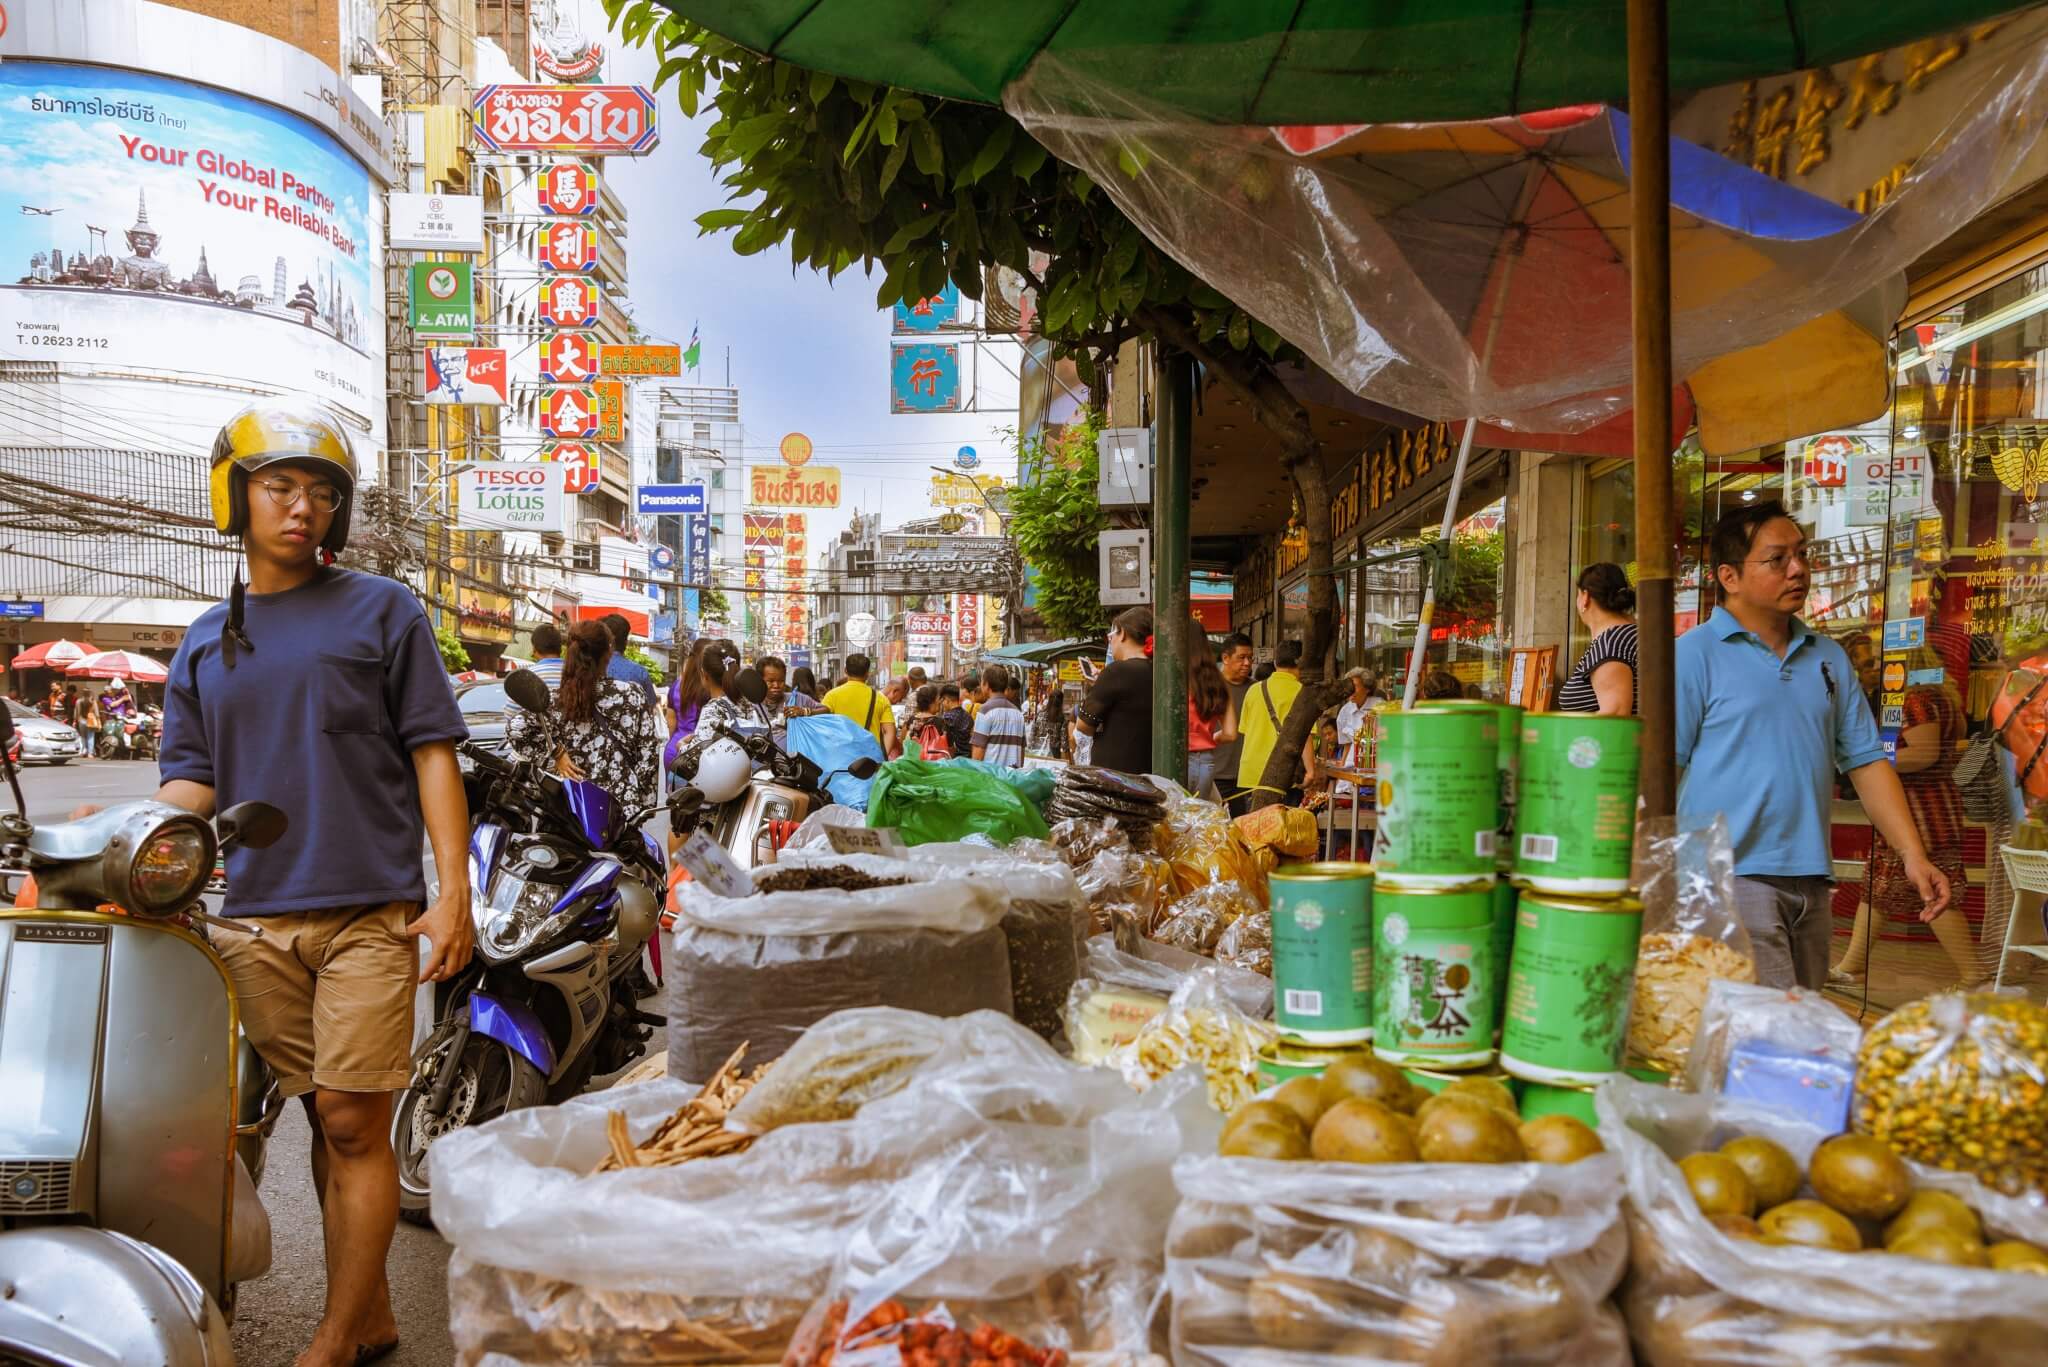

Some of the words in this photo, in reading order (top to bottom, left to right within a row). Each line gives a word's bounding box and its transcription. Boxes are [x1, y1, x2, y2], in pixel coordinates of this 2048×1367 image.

[493, 89, 563, 108] ห้างทอง
[31, 97, 155, 124] ธนาคารไอซีบีซี
[158, 113, 187, 131] (ไทย)
[491, 90, 639, 143] ทองใบ
[119, 134, 189, 167] Your
[196, 149, 276, 188] Global
[282, 172, 335, 215] Partner
[198, 179, 257, 214] Your
[264, 196, 330, 242] Reliable
[332, 226, 356, 260] Bank
[16, 320, 60, 333] Yaowaraj
[435, 314, 469, 327] ATM
[17, 335, 29, 346] T.
[31, 335, 40, 346] 0
[42, 336, 74, 347] 2623
[77, 338, 109, 349] 2112
[602, 346, 679, 373] รงรับจำนำ
[470, 359, 500, 377] KFC
[473, 471, 545, 486] TESCO
[478, 492, 545, 511] Lotus
[640, 494, 702, 505] Panasonic
[506, 511, 545, 522] ตลาด
[132, 632, 159, 641] ICBC
[1884, 710, 1901, 722] VISA
[25, 928, 97, 938] PIAGGIO
